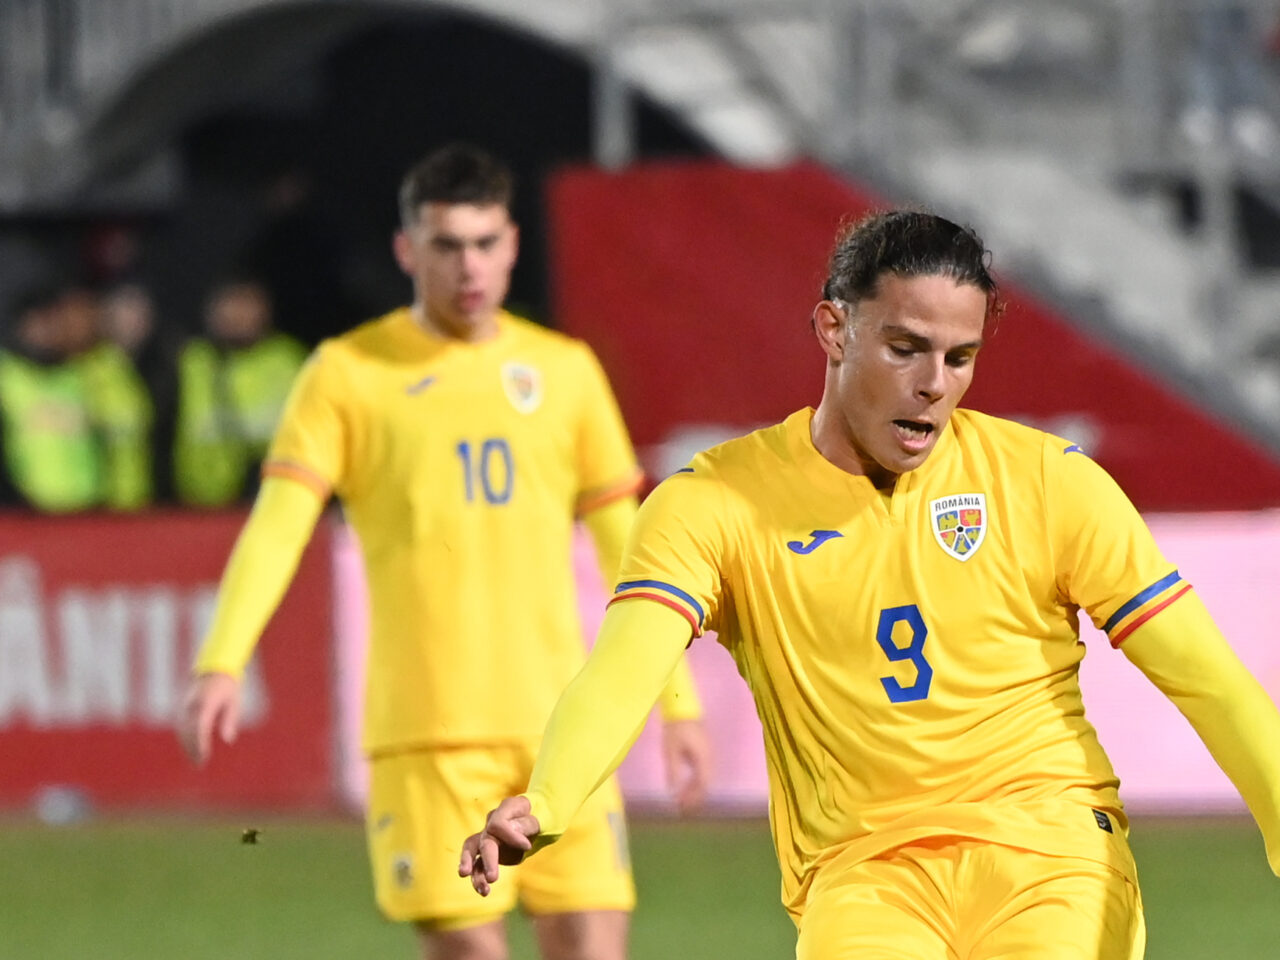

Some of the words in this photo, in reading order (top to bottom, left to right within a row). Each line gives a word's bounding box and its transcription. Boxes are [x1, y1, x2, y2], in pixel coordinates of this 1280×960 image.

[456, 438, 514, 505] 10
[934, 496, 980, 511] ROMÂNIA
[876, 604, 933, 703] 9
